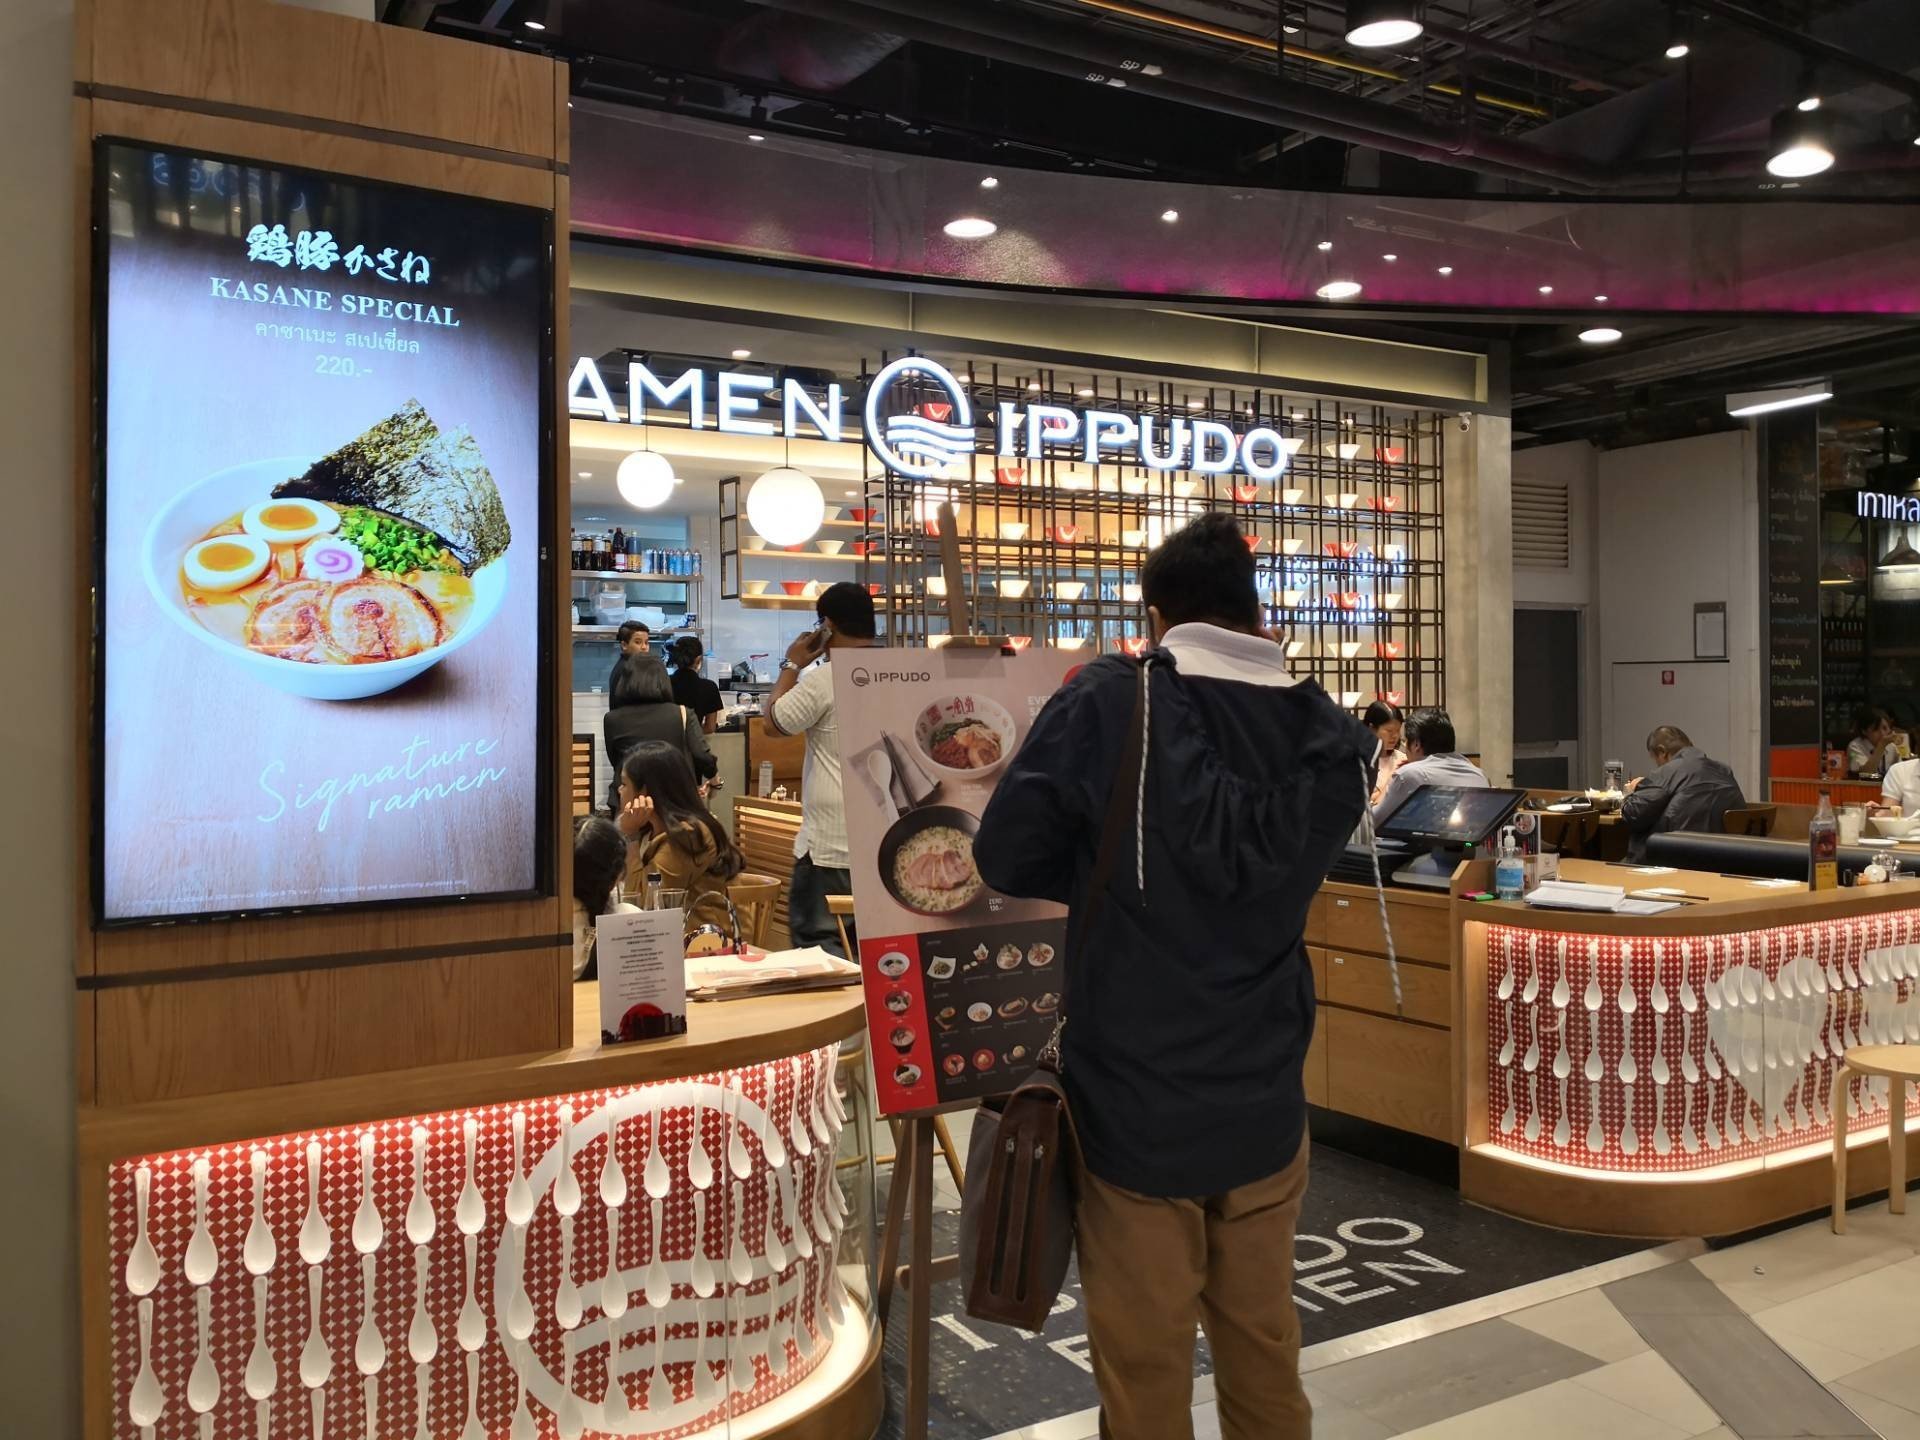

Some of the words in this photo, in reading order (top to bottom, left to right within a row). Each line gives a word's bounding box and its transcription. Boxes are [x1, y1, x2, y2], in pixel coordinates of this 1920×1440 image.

[209, 277, 331, 312] KASANE
[341, 294, 460, 327] SPECIAL
[255, 322, 336, 344] คาซาเนะ
[315, 354, 373, 377] 220.-
[999, 401, 1290, 480] IPPUDO
[874, 671, 931, 683] IPPUDO
[256, 734, 499, 833] Signature
[367, 766, 506, 820] ramen
